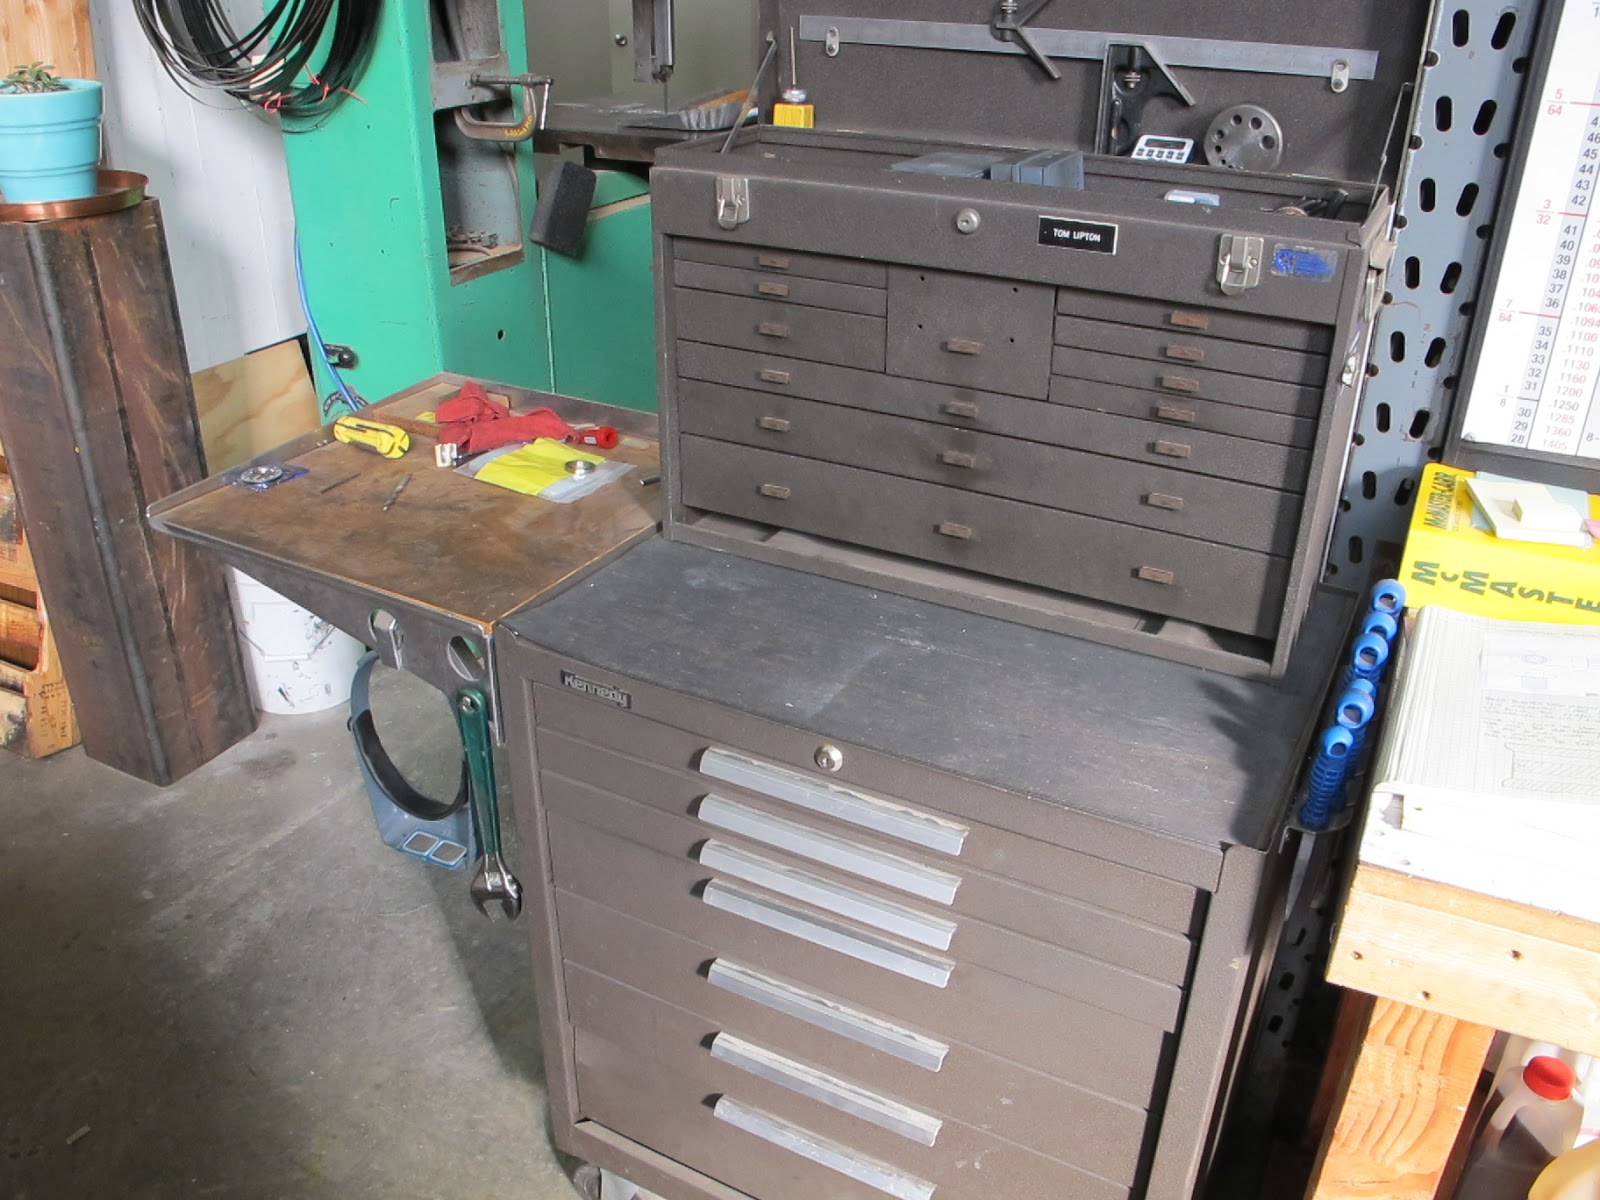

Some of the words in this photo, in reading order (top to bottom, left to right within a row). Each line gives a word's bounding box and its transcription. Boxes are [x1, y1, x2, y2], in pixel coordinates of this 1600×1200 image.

[1555, 88, 1563, 99] 5
[1547, 104, 1563, 115] 64
[1587, 132, 1600, 144] 46
[1583, 148, 1598, 160] 45
[1579, 163, 1594, 175] 44
[1575, 179, 1590, 191] 43
[1543, 199, 1551, 209] 3
[1571, 195, 1587, 206] 42
[1536, 214, 1551, 225] 32
[1053, 228, 1070, 239] TOM
[1073, 230, 1101, 243] LIPTON
[1563, 225, 1578, 236] 41
[1560, 240, 1575, 251] 40
[1556, 254, 1571, 265] 39
[1552, 269, 1567, 280] 38
[1548, 283, 1564, 294] 37
[1506, 299, 1513, 309] 7
[1545, 297, 1560, 308] 36
[1498, 312, 1512, 323] 64
[1538, 326, 1552, 337] 35
[1534, 340, 1549, 350] 34
[1531, 354, 1545, 365] 33
[1527, 367, 1542, 378] 32
[1504, 384, 1509, 393] 1
[1524, 380, 1538, 391] 31
[1499, 398, 1507, 408] 8
[1517, 407, 1532, 418] 30
[1514, 420, 1528, 431] 29
[1510, 433, 1525, 444] 28
[564, 673, 628, 708] Kennedy
